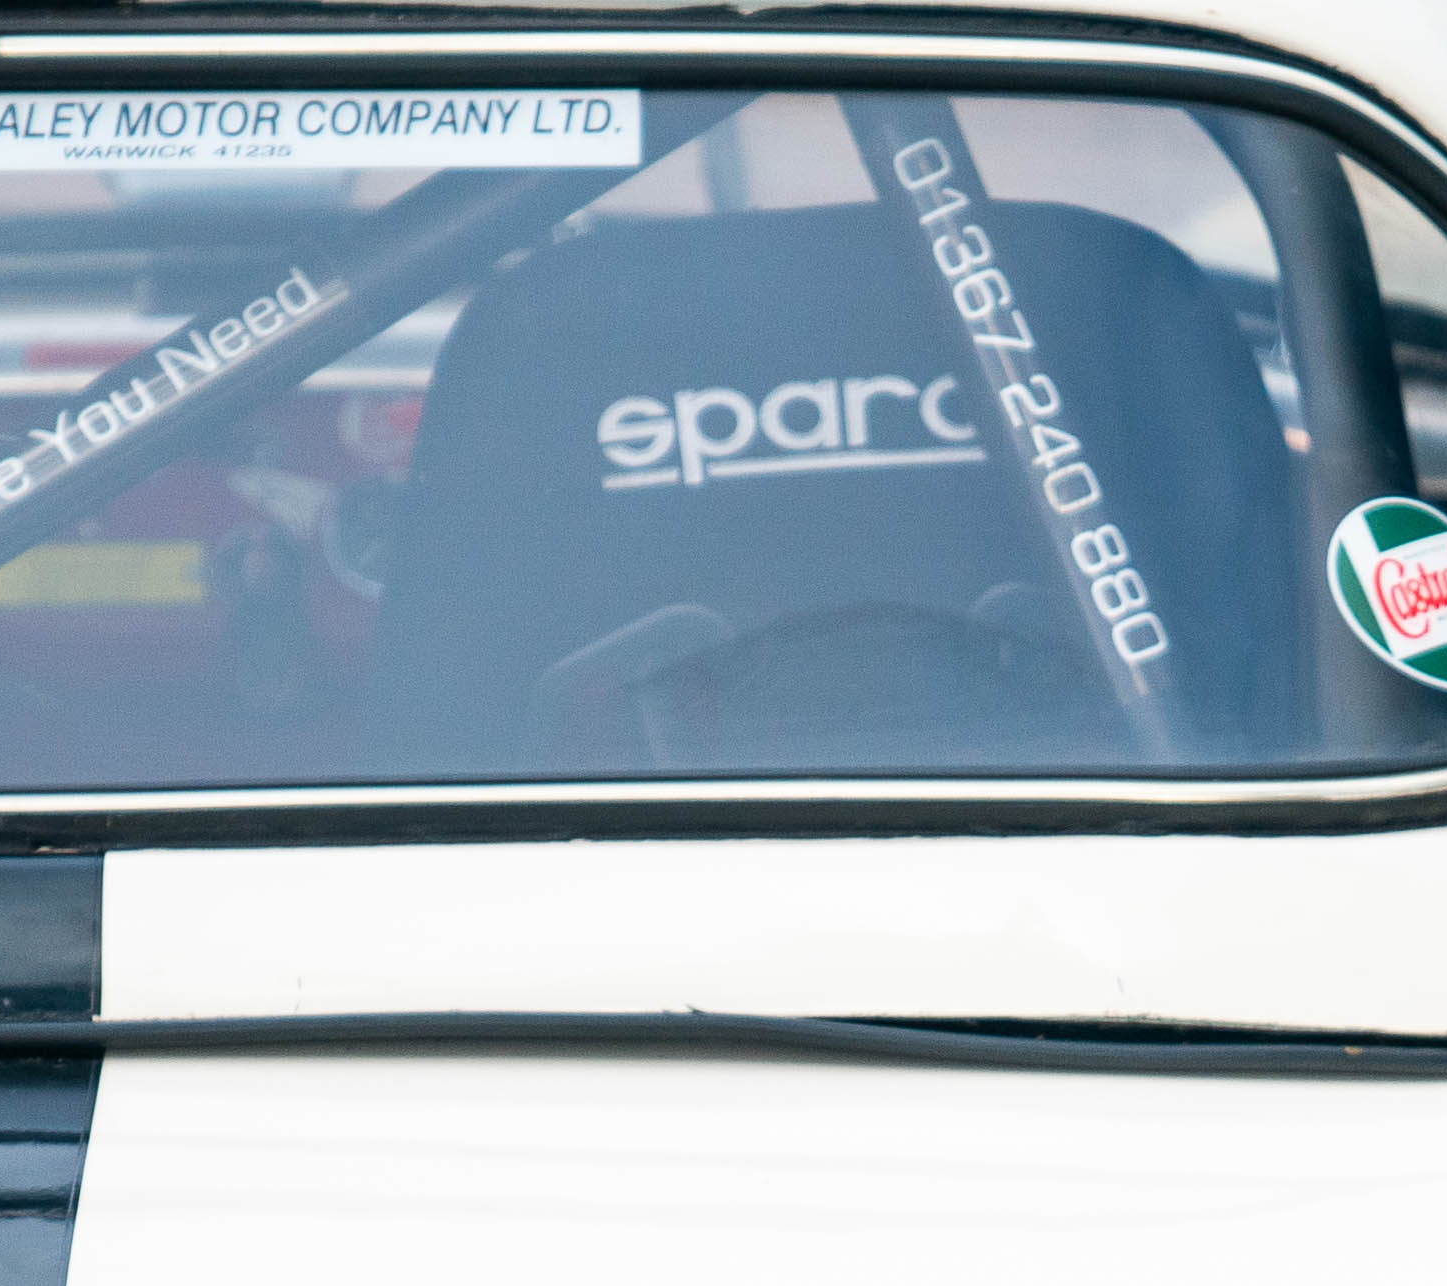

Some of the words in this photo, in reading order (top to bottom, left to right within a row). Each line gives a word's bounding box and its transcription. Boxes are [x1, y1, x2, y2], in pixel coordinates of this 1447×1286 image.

[63, 144, 197, 159] WARWICK
[213, 144, 293, 158] 41235
[115, 101, 279, 140] MOTOR
[299, 99, 519, 138] COMPANY
[532, 98, 623, 137] LTD.
[29, 377, 156, 464] You
[155, 267, 322, 393] Need
[893, 138, 1035, 353] 01367
[1000, 373, 1102, 514] 240
[1071, 523, 1169, 664] 880
